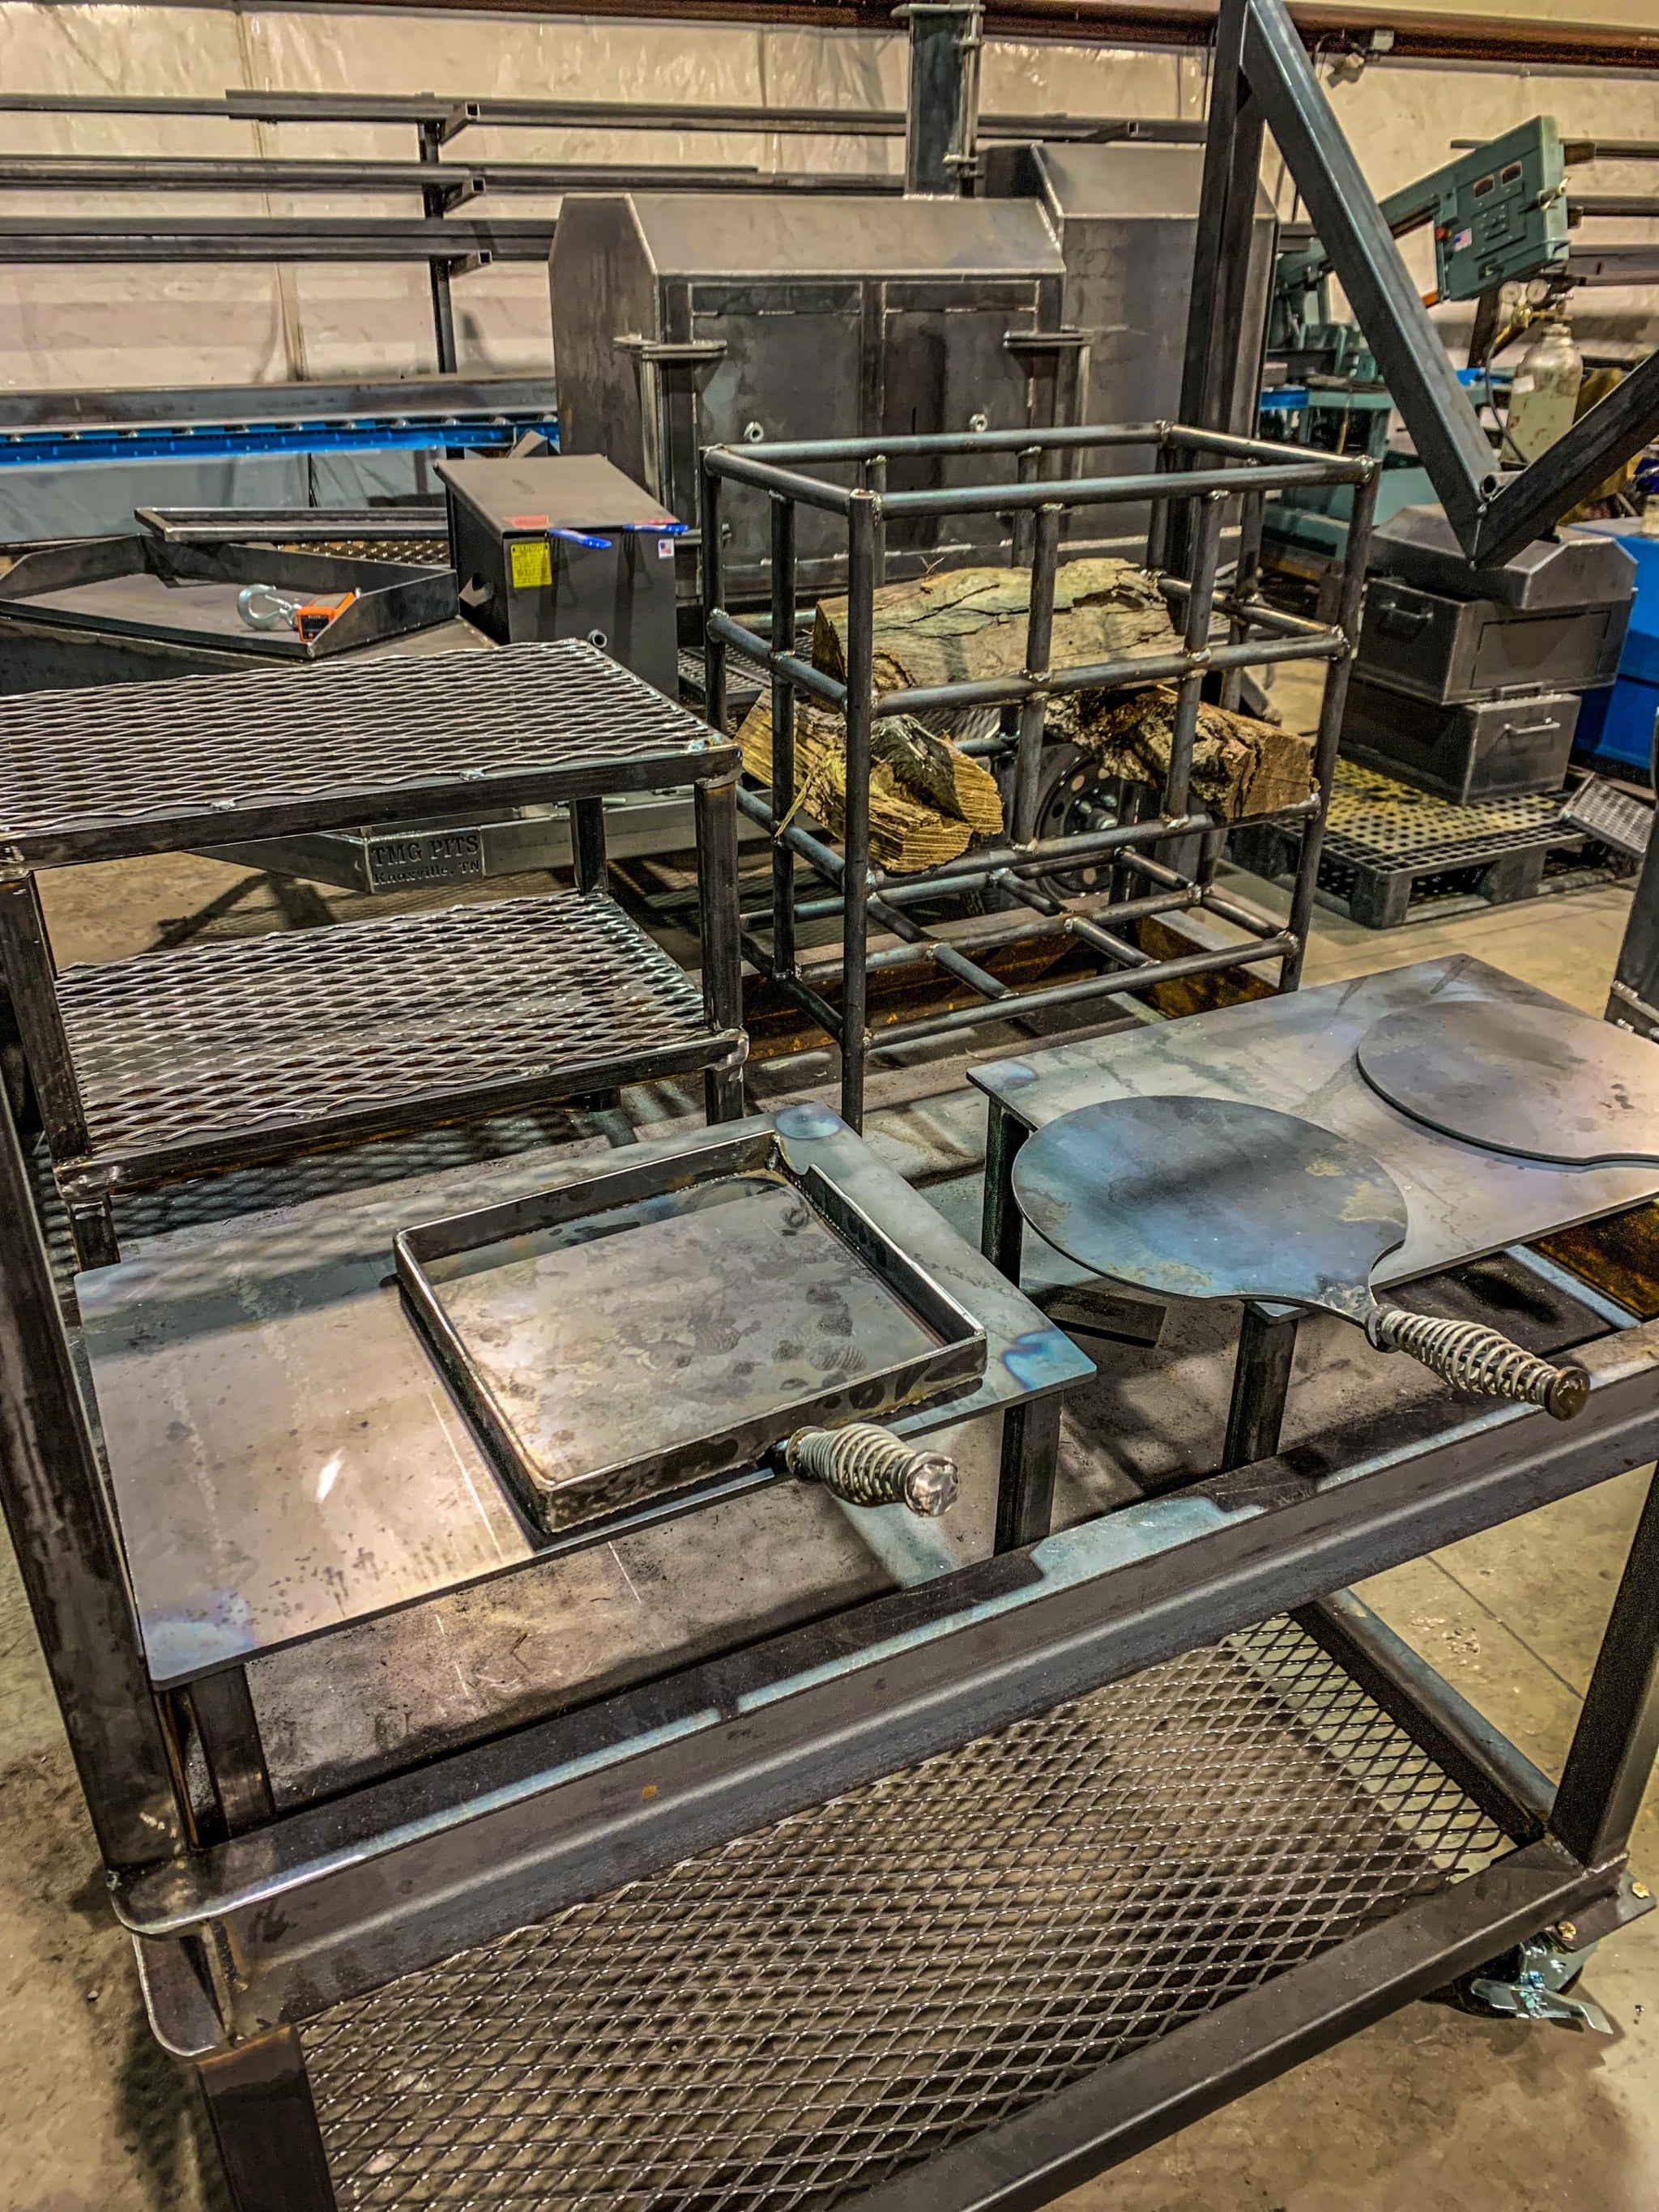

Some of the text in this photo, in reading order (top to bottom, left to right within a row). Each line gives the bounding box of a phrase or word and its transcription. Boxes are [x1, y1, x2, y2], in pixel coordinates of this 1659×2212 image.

[371, 835, 480, 867] TMG PITS
[373, 860, 480, 885] Knoxville, TN
